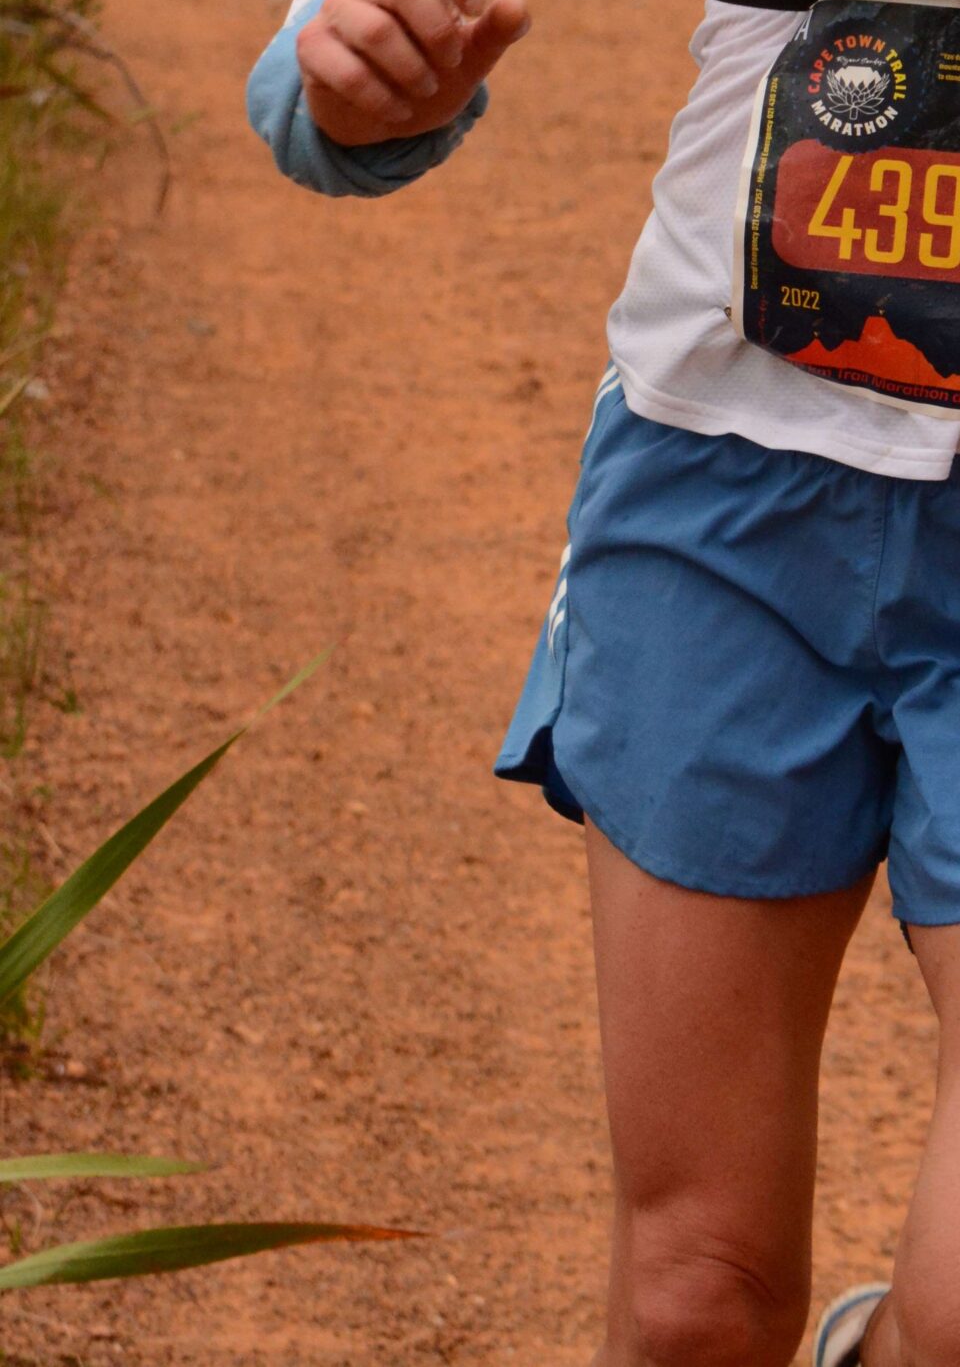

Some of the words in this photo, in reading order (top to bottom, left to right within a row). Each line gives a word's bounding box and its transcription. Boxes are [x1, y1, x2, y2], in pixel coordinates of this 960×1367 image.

[807, 49, 834, 94] CAPE
[833, 34, 886, 53] TOWN
[885, 48, 907, 100] TRAIL
[811, 99, 899, 136] MARATHON
[780, 286, 820, 310] 2022
[872, 375, 949, 401] Marathon
